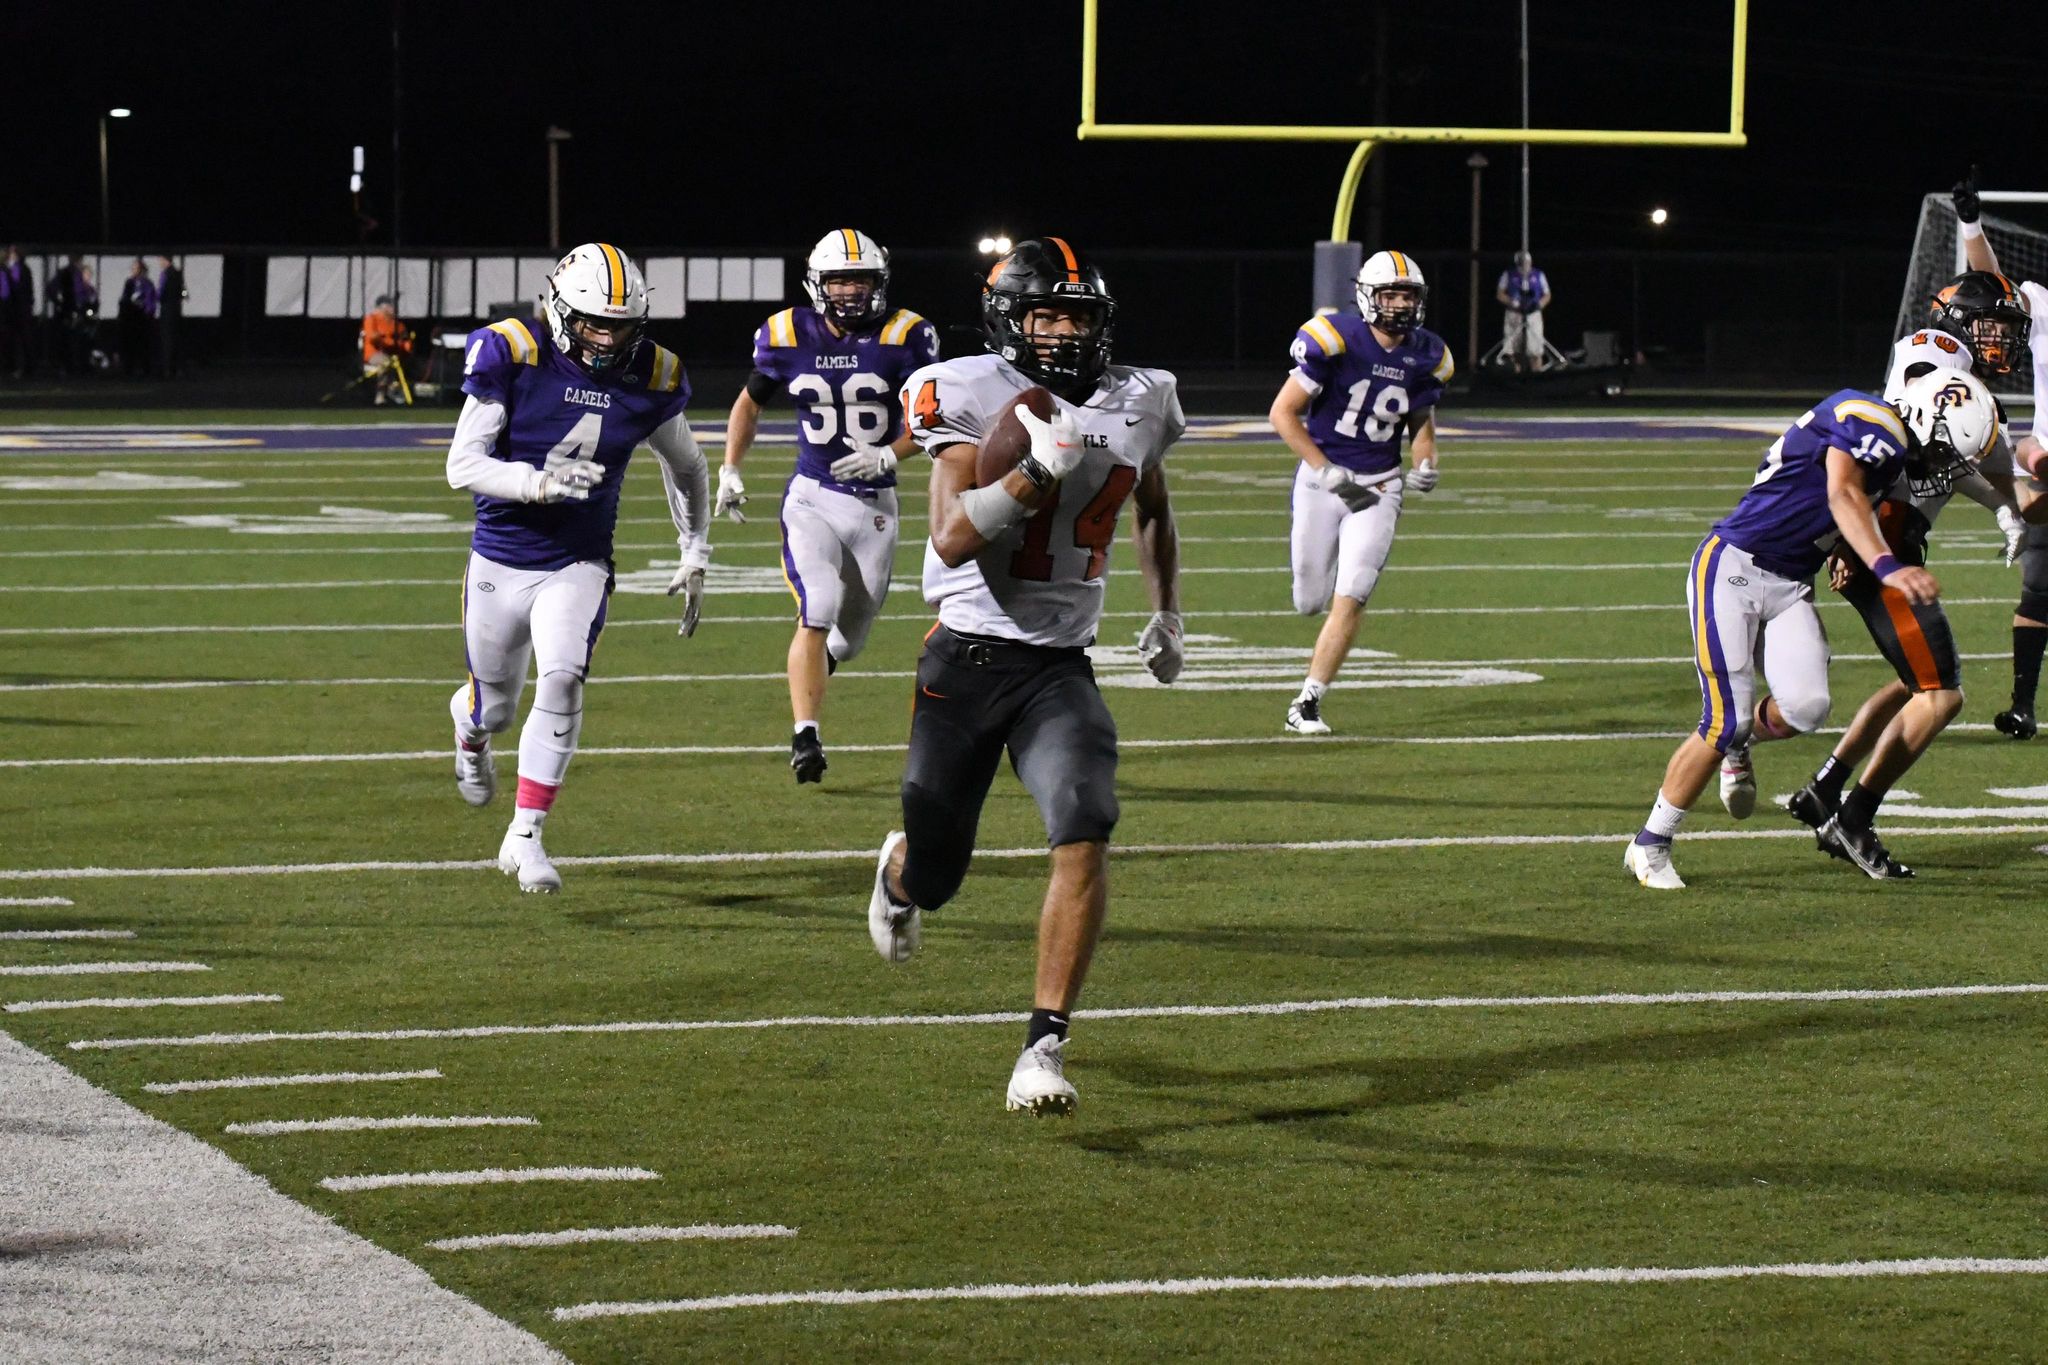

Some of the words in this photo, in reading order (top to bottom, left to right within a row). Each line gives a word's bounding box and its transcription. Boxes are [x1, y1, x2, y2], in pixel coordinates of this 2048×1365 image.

[463, 338, 484, 375] 4
[924, 325, 941, 357] 3
[815, 354, 859, 369] CAMELS
[1371, 364, 1406, 381] CAMELS
[564, 386, 611, 409] CAMELS
[788, 371, 890, 447] 36
[1334, 378, 1410, 443] 18
[542, 412, 603, 470] 4
[1081, 433, 1109, 448] YLE
[1850, 433, 1897, 467] 15
[1008, 464, 1138, 582] 14
